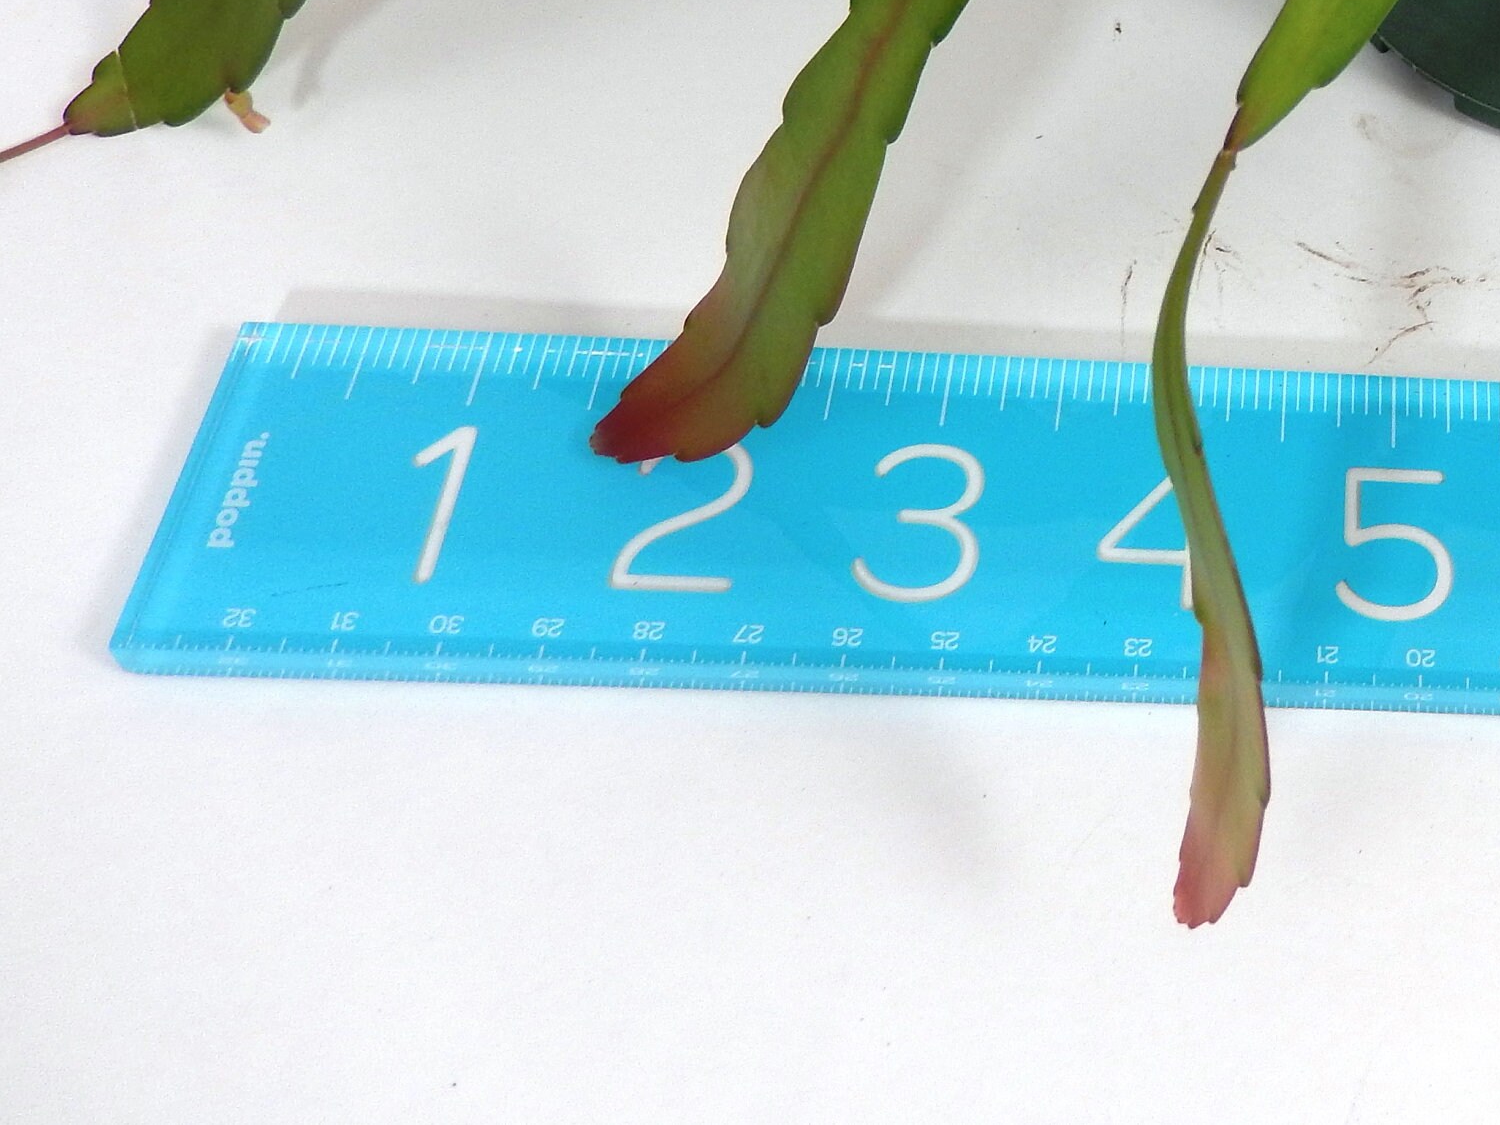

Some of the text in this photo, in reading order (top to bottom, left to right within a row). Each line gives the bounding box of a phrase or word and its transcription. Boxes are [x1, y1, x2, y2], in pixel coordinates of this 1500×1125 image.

[410, 425, 478, 584] 1
[608, 441, 753, 593] 2
[852, 442, 985, 603] 3
[1335, 467, 1454, 622] 5
[219, 606, 258, 629] 32
[329, 610, 361, 632] 31
[426, 613, 465, 635] 30
[530, 616, 567, 639] 29
[631, 620, 667, 641] 28
[731, 623, 766, 645] 27
[831, 626, 865, 648] 26
[929, 630, 961, 652] 25
[1026, 633, 1059, 655] 24
[1123, 636, 1153, 658] 23
[1316, 644, 1340, 665] 21
[1404, 647, 1437, 668] 20
